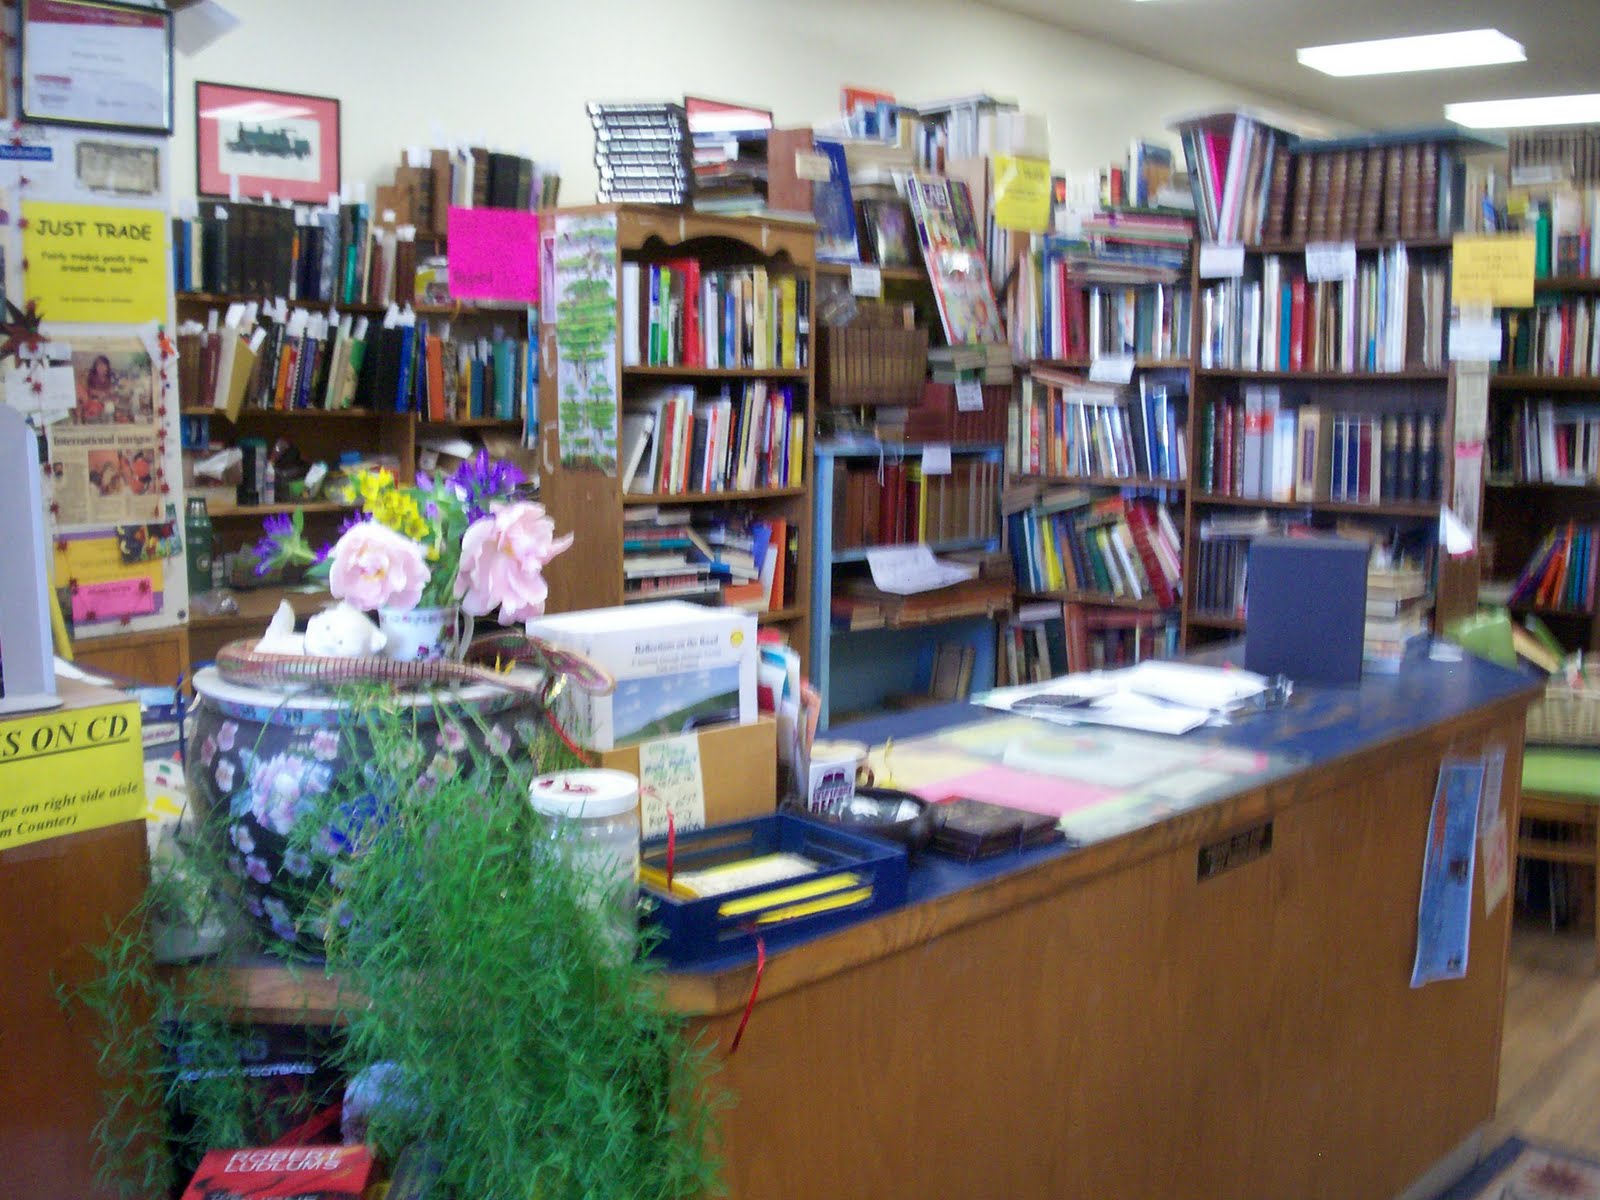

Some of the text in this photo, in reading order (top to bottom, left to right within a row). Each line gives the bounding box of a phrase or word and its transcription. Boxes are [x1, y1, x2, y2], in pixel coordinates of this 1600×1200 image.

[36, 219, 153, 241] JUST TRADE
[54, 435, 115, 447] International
[31, 721, 78, 752] ON
[86, 714, 129, 743] CD
[21, 803, 40, 814] on
[43, 795, 77, 811] right
[80, 788, 106, 803] side
[109, 781, 139, 797] aisle
